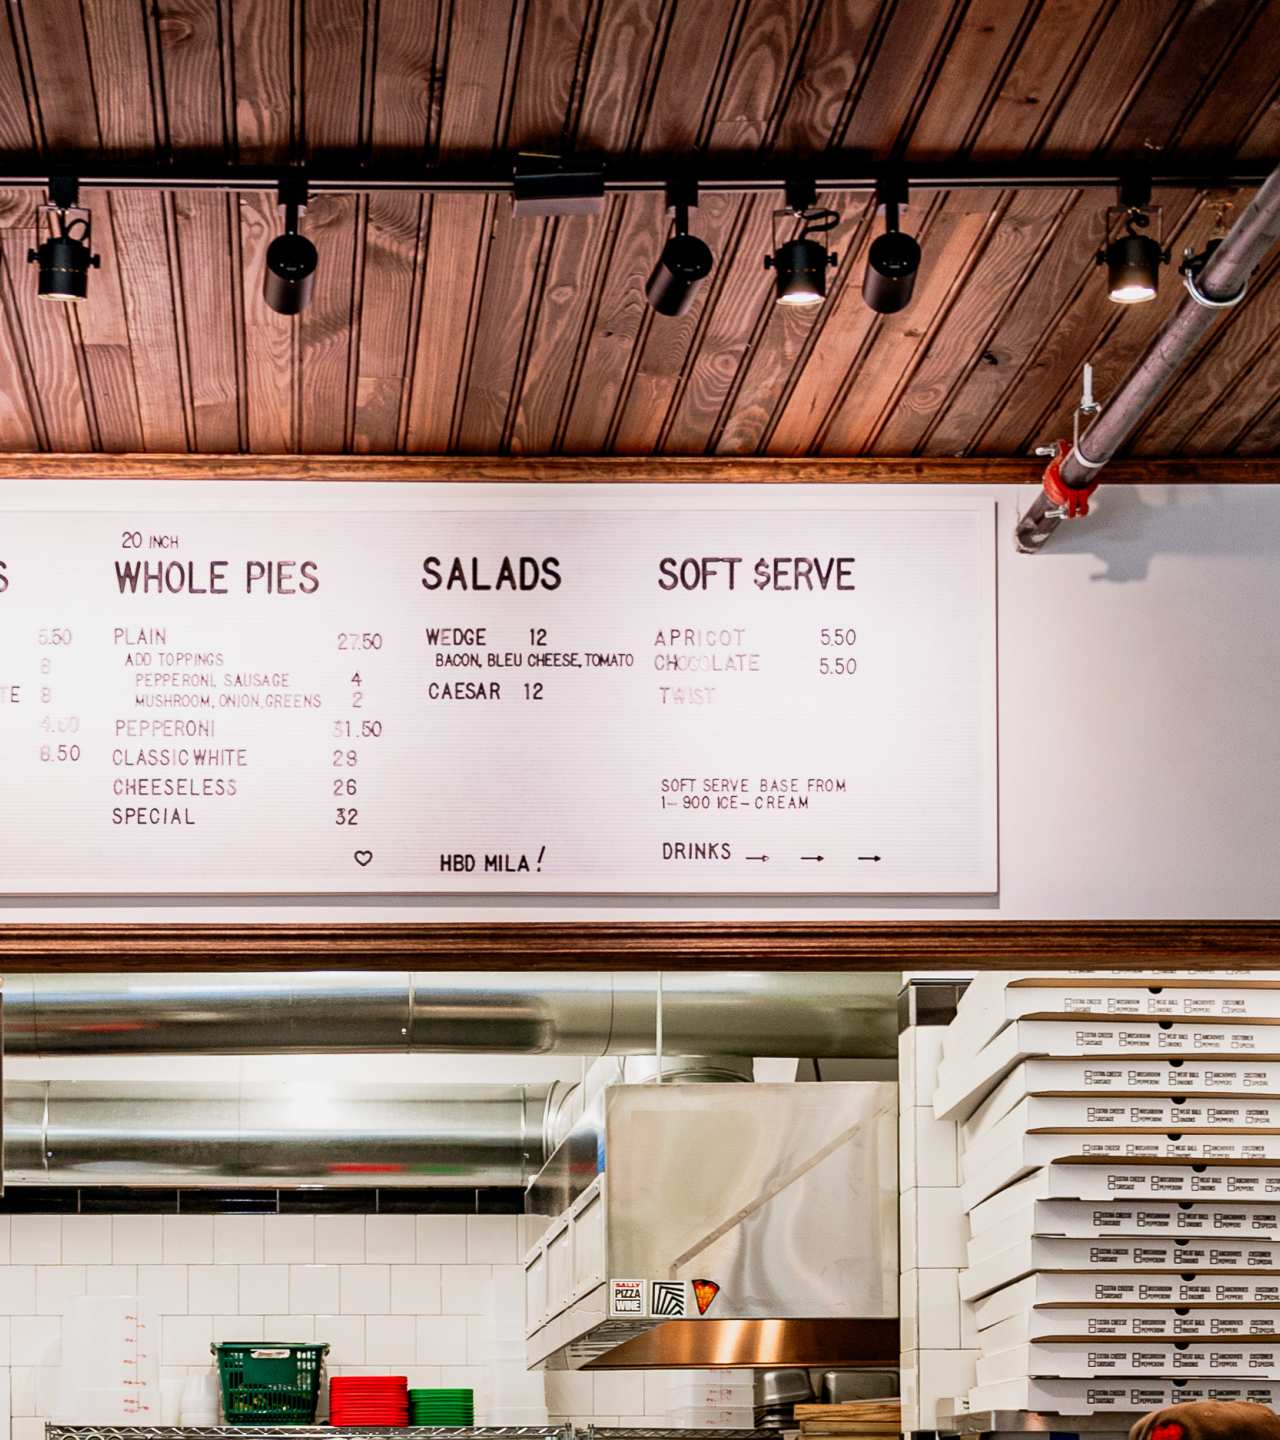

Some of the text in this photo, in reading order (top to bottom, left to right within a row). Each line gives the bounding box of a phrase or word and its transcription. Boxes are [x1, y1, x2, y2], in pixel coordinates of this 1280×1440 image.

[122, 531, 178, 549] 20 INCH
[115, 561, 319, 594] WHOLE PIES
[422, 556, 561, 591] SALADS
[658, 557, 743, 590] SOFT
[114, 628, 166, 645] PLAIN
[426, 628, 547, 646] WEDGE 12
[654, 629, 856, 646] APRICOT 5.50
[125, 652, 224, 666] ADD TOPPINGS
[436, 653, 482, 668] BACON,
[488, 653, 522, 667] BLEU
[584, 653, 633, 667] TOMATO
[654, 655, 857, 675] CHOCOLATE 5.50
[224, 673, 289, 687] SAUSAGE
[351, 672, 362, 687] 4
[429, 682, 543, 700] CAESAR 12
[659, 686, 717, 703] TWIST
[352, 692, 363, 708] 2
[115, 720, 215, 737] PEPPERONI
[113, 749, 193, 766] CLASSIC
[194, 749, 248, 766] WHITE
[113, 778, 357, 796] CHEESELESS 26
[661, 778, 846, 793] SOFT SERVE BASE FROM
[112, 807, 358, 825] SPECIAL 32
[663, 842, 731, 860] DRINKS
[440, 854, 475, 872] HBD
[615, 1289, 640, 1298] PIZZA
